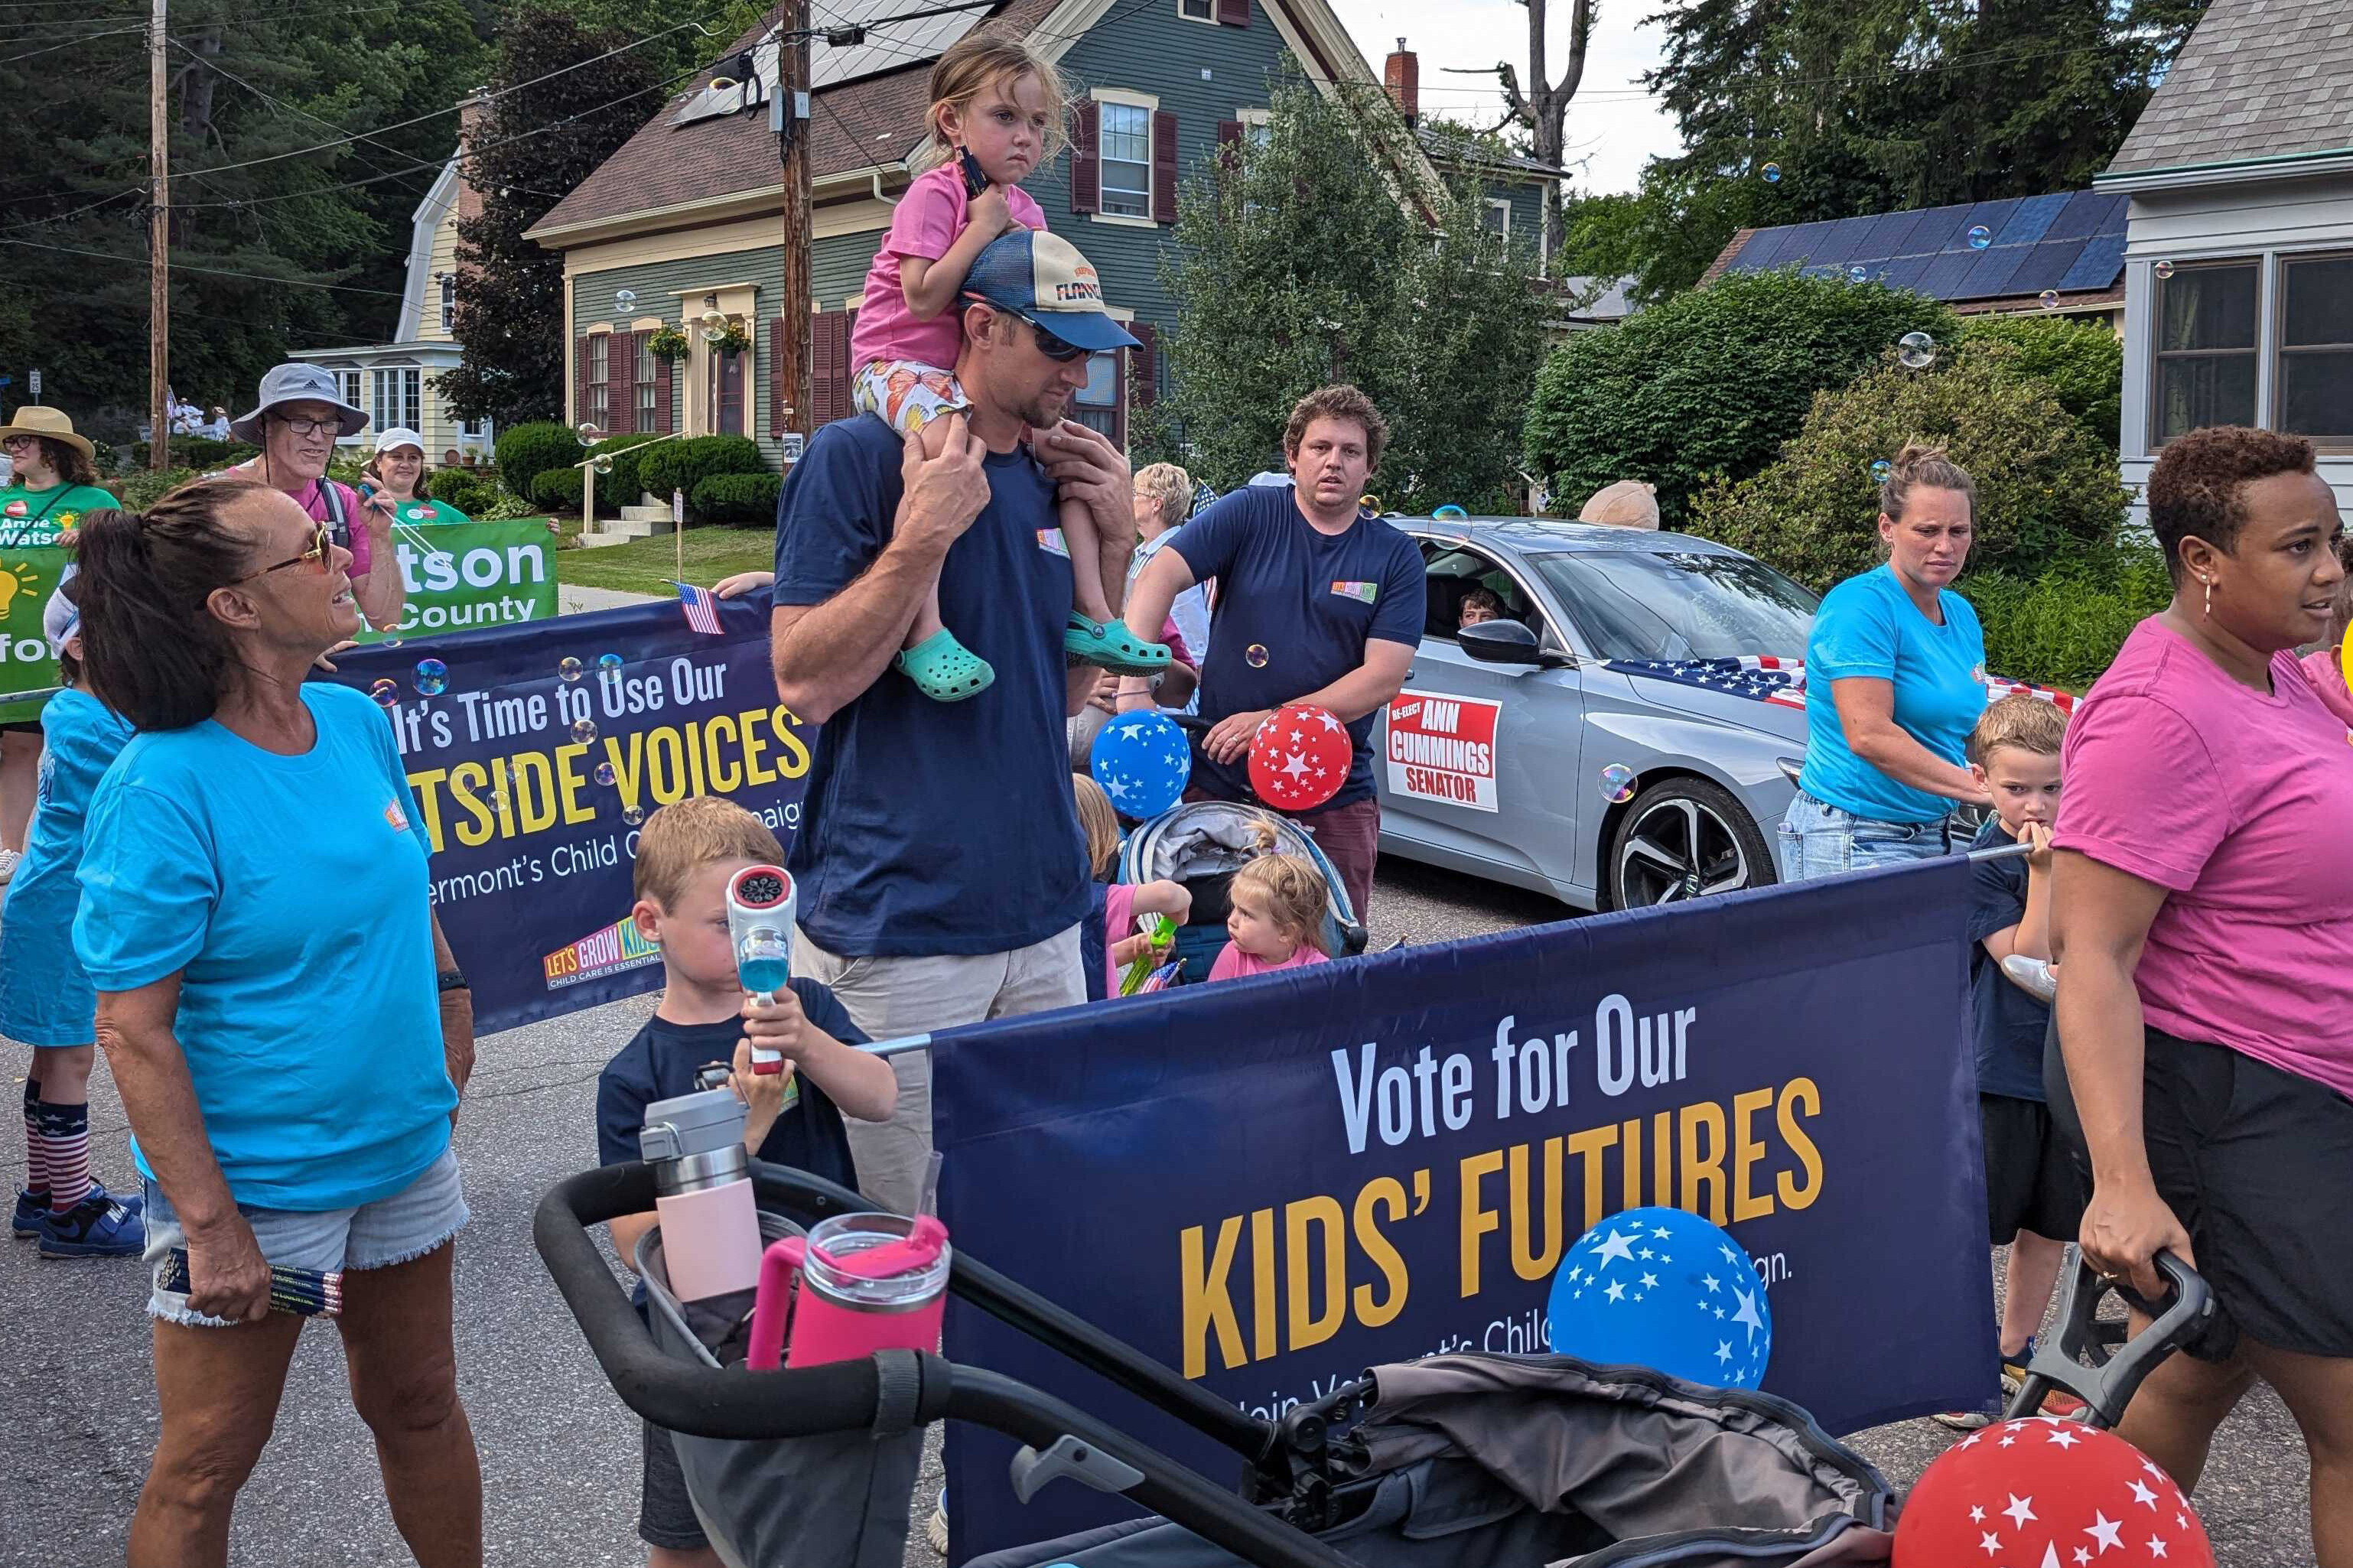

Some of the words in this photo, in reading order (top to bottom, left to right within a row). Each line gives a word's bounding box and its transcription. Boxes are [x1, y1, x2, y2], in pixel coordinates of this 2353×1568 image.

[392, 700, 453, 755] It's
[457, 691, 548, 743] Time
[555, 683, 591, 726] to
[599, 669, 664, 718] Use
[671, 657, 727, 705] Our
[1391, 701, 1421, 721] RE-ELECT
[1421, 698, 1460, 734] ANN
[604, 704, 811, 811] VOICES
[1391, 730, 1490, 775] CUMMINGS
[1405, 766, 1476, 803] SENATOR
[551, 834, 618, 877] Child
[546, 946, 578, 978] LET'S
[578, 926, 619, 969] GROW
[549, 975, 577, 988] CHILD
[579, 968, 603, 981] CARE
[613, 954, 661, 972] ESSENTIAL
[1330, 1042, 1473, 1154] Vote
[1492, 1015, 1578, 1121] for
[1595, 993, 1697, 1097] Our
[1180, 1167, 1431, 1381] KIDS'
[1460, 1076, 1824, 1299] FUTURES
